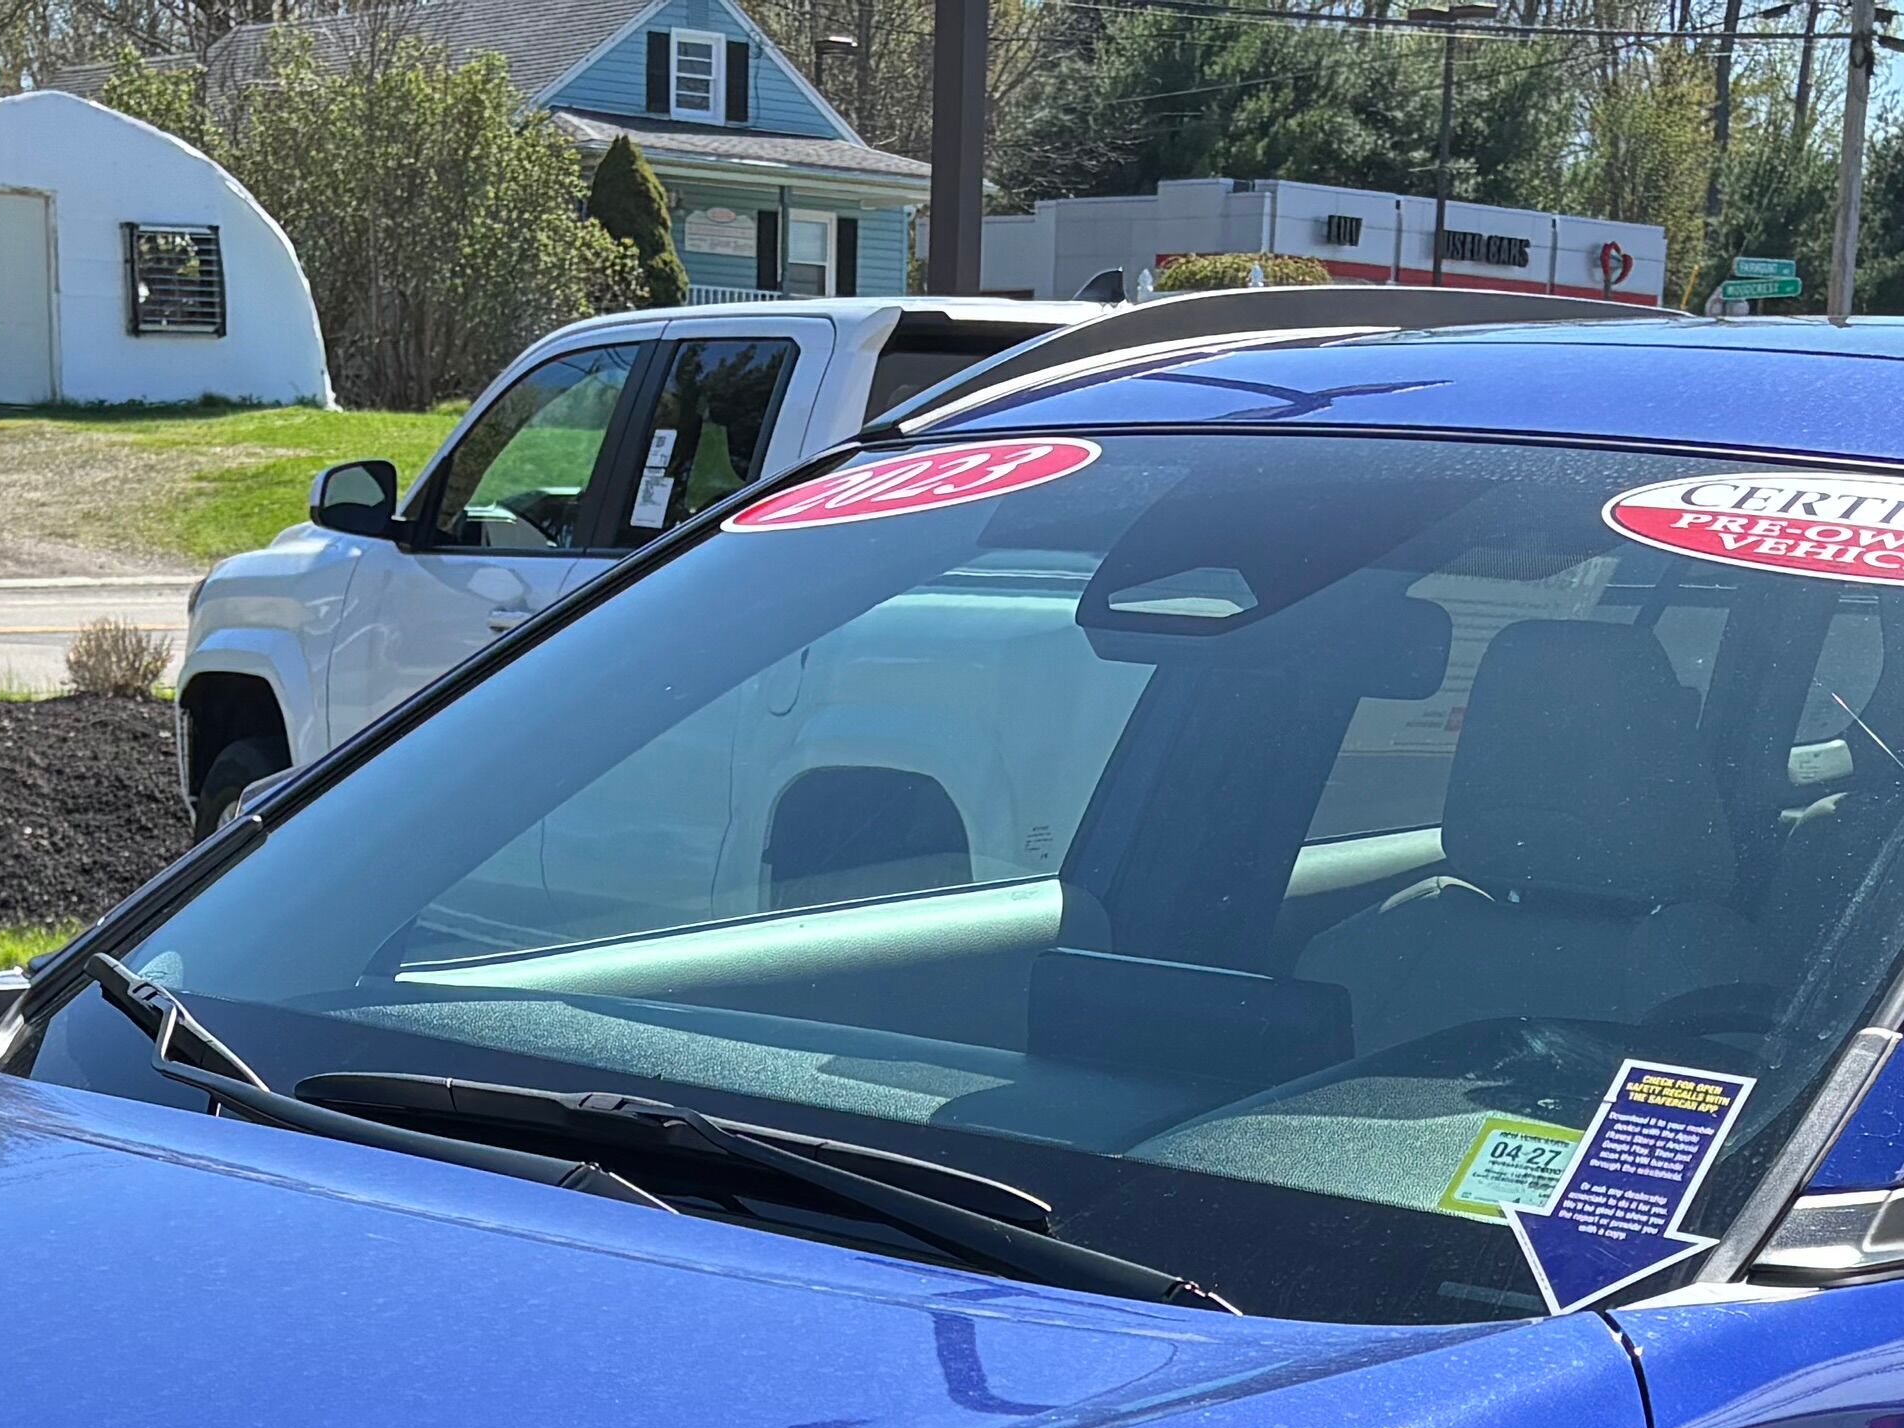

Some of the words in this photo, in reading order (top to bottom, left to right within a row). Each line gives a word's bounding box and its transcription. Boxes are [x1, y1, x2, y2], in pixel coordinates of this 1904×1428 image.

[1487, 234, 1530, 268] CARS
[759, 444, 1054, 523] 2023
[1626, 1082, 1662, 1094] SAFETY
[1662, 1087, 1705, 1101] RECALLS
[1705, 1094, 1731, 1106] WITH
[1642, 1075, 1675, 1087] CHECK
[1675, 1080, 1696, 1090] FOR
[1696, 1083, 1723, 1094] OPEN
[1628, 1092, 1648, 1102] THE
